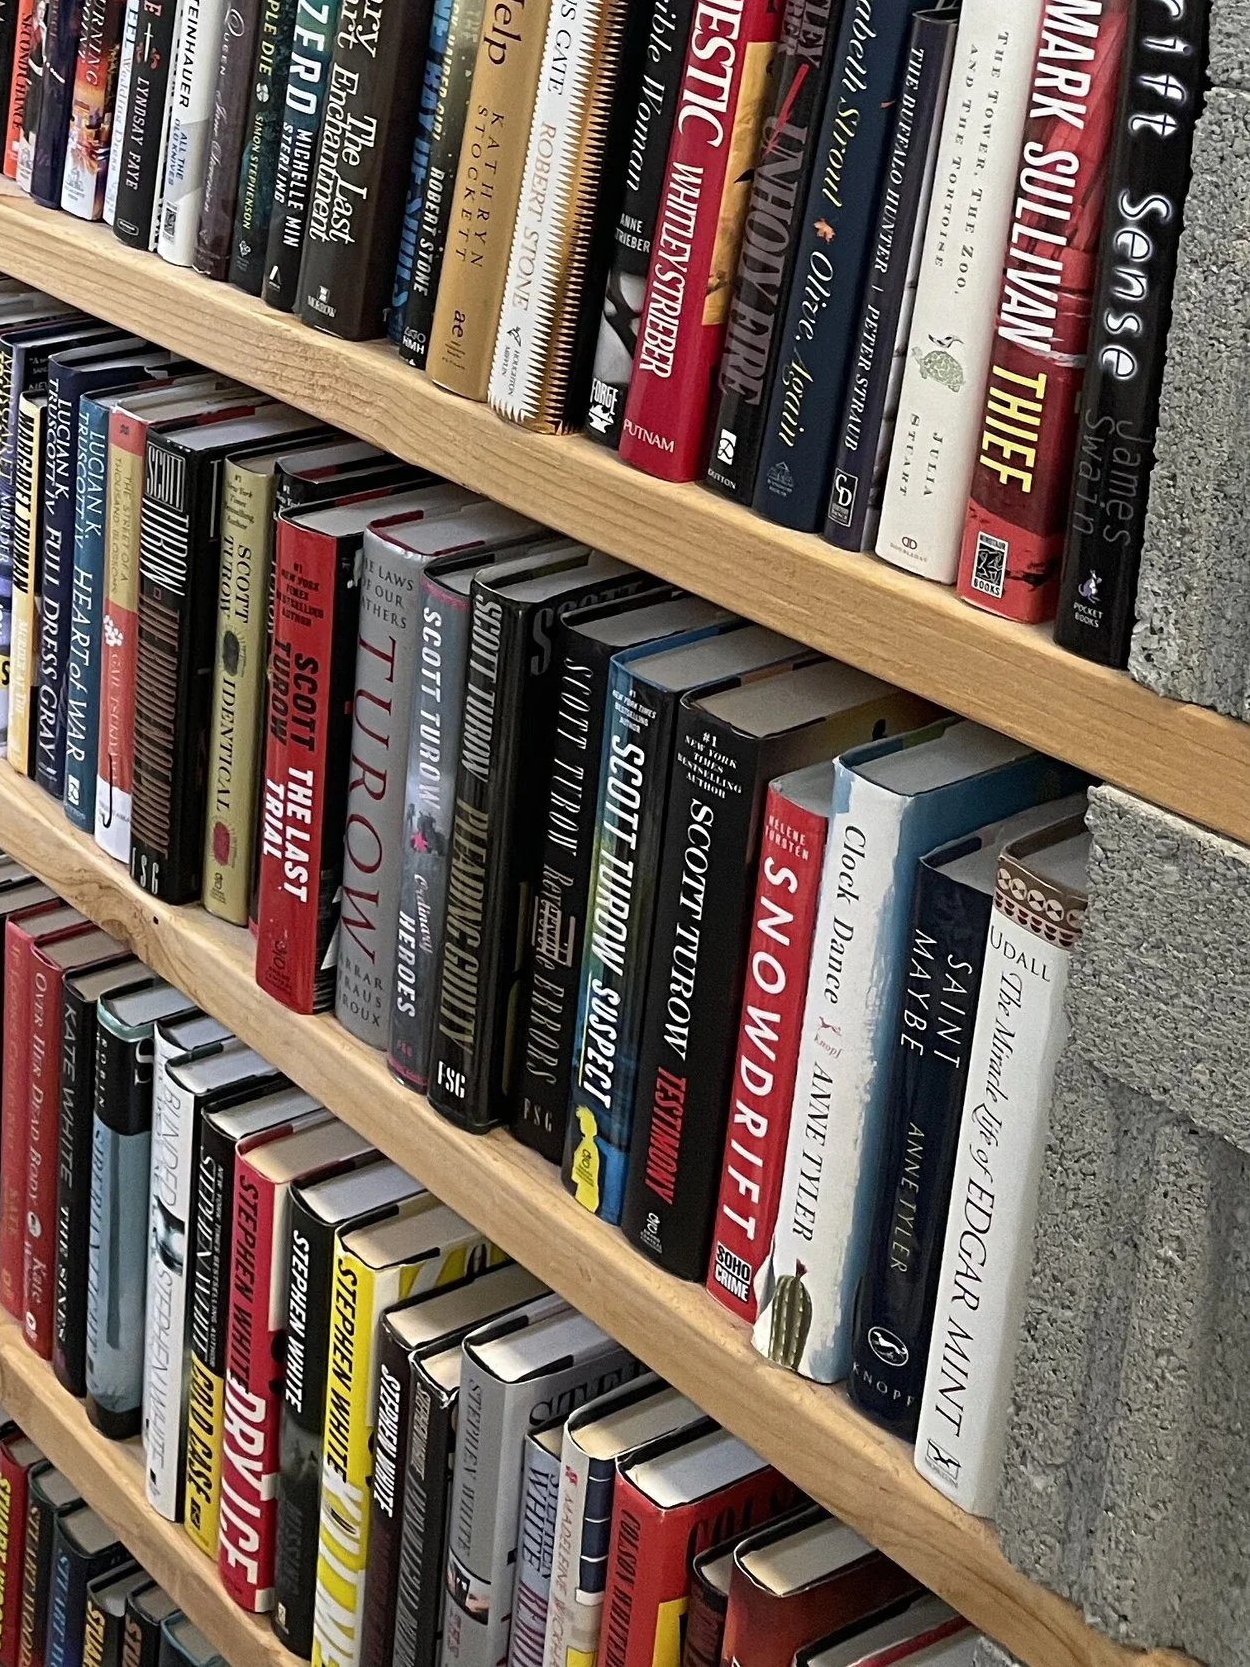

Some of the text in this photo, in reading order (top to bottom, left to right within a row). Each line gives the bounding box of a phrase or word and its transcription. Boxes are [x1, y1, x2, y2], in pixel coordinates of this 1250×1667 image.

[286, 2, 332, 125] ZERO
[544, 27, 580, 96] GATE
[302, 63, 360, 242] Enchantment
[329, 113, 379, 245] The Last
[527, 122, 557, 221] ROBERT
[658, 161, 703, 273] WHITLEY
[512, 226, 541, 314] STONE
[995, 140, 1085, 353] SULLIVAN
[1098, 184, 1176, 385] Sense
[639, 262, 688, 379] STRIEBER
[590, 377, 619, 411] FORGE
[623, 417, 675, 453] PUTNAM
[975, 365, 1050, 495] THIEF
[212, 675, 236, 813] IDENTICAL
[261, 641, 295, 860] TUROW TRIAL
[282, 651, 320, 903] SCOTT THE LAST
[338, 635, 399, 967] TUROW
[394, 908, 418, 1019] HEROES
[578, 732, 648, 1113] SCOTT TUROW SUSPECT
[821, 822, 871, 1008] Clock Dance
[642, 797, 719, 1206] SCOTT TUROW TESTIMONY
[721, 857, 801, 1242] SNOWDRIFT
[899, 929, 941, 1058] MAYBE
[934, 953, 975, 1070] SAINT
[437, 1060, 468, 1100] FSG
[714, 1266, 751, 1303] CRIME
[716, 1242, 752, 1278] SOHO
[933, 1175, 999, 1439] EDGAR MINT
[851, 1361, 917, 1409] KNOPF
[220, 1370, 267, 1584] DRY ICE
